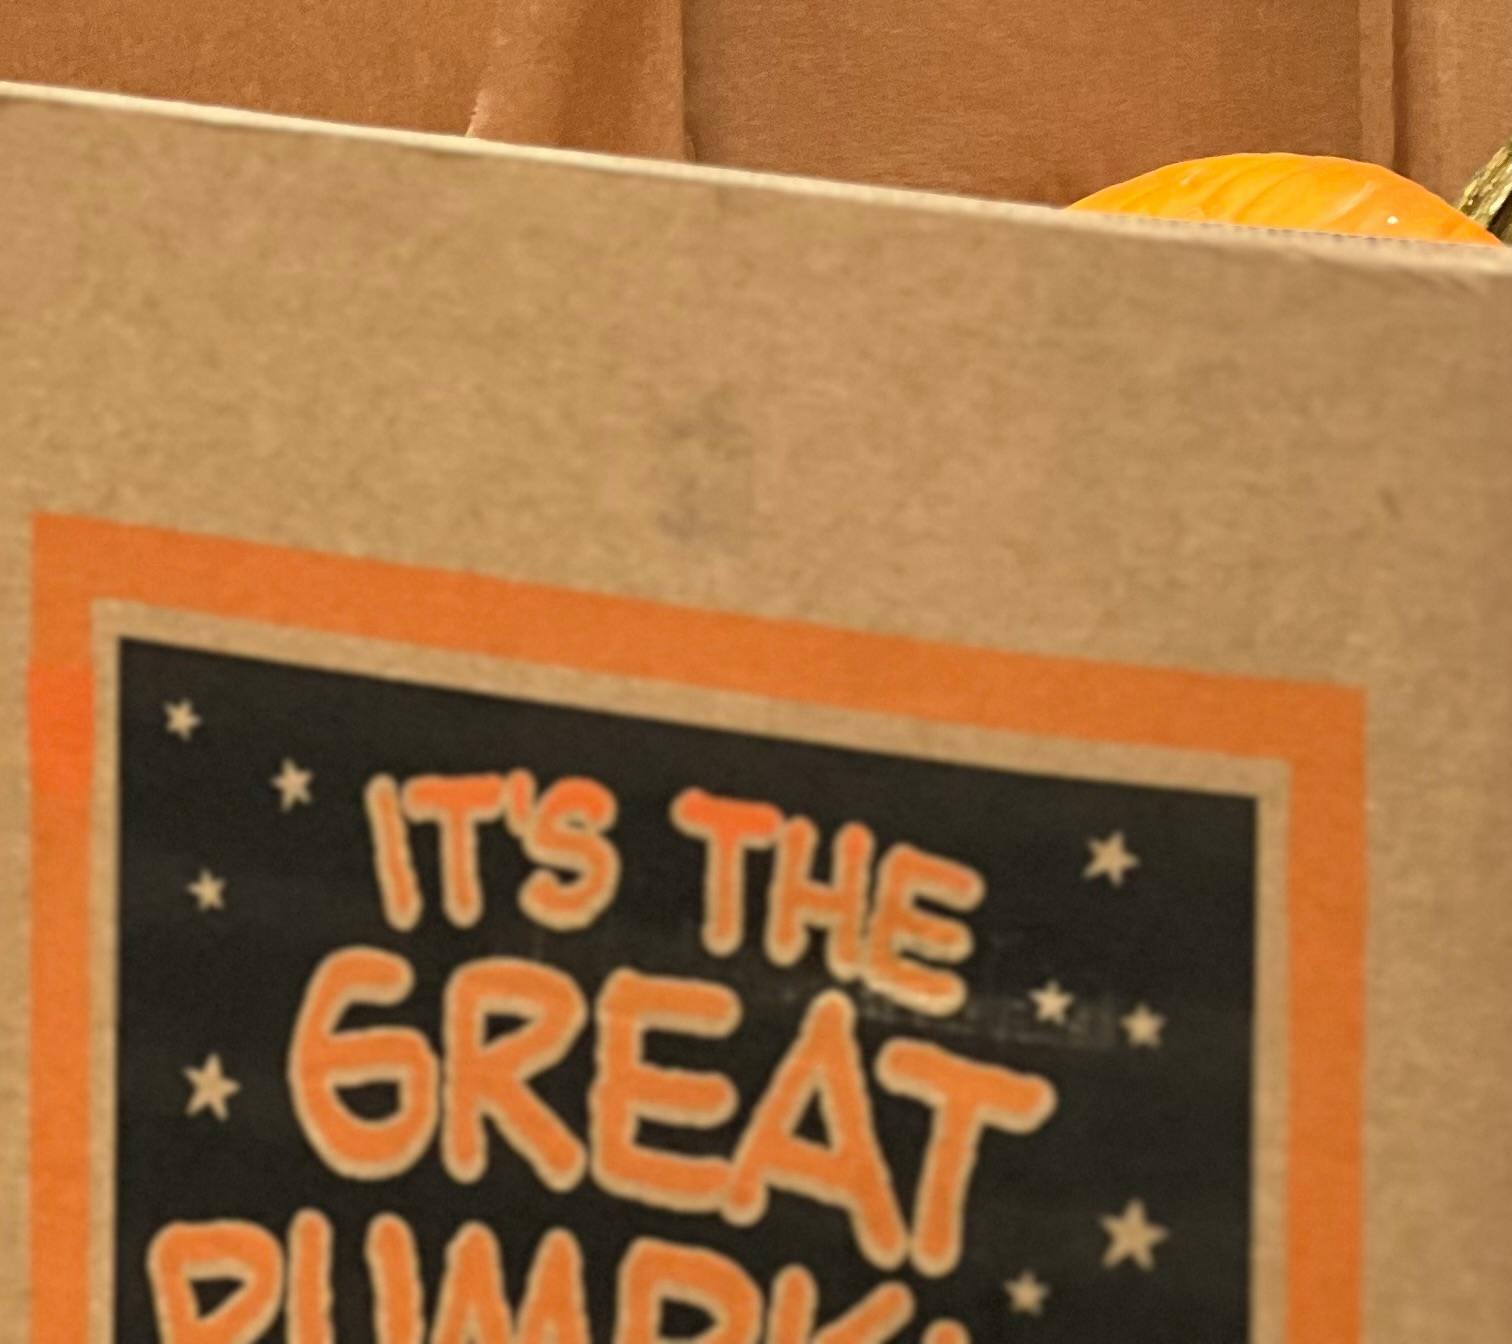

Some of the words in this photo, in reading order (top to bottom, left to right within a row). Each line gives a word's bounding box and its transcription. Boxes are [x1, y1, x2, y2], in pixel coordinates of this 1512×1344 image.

[365, 768, 621, 932] IT'S
[669, 787, 984, 1015] THE
[288, 946, 1057, 1277] GREAT
